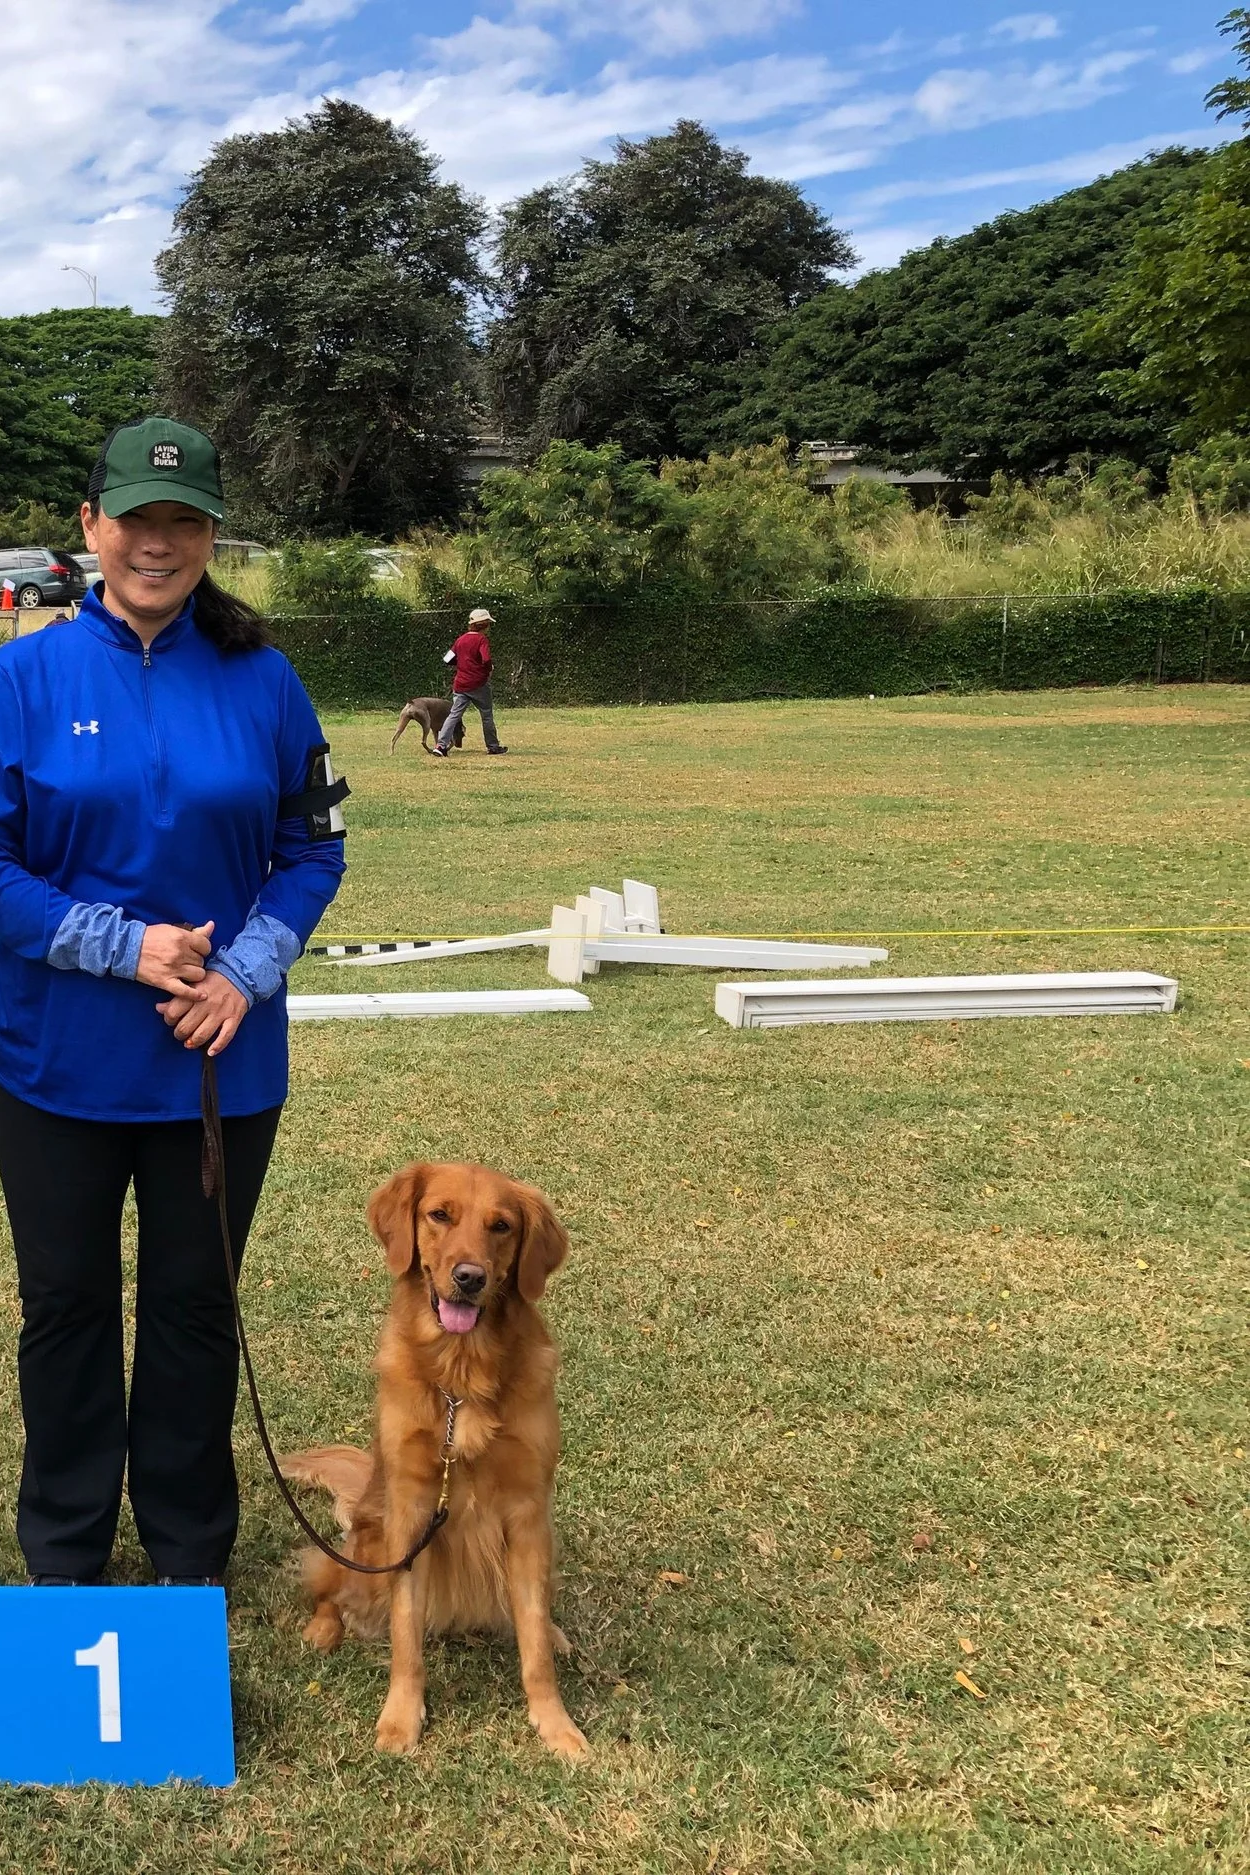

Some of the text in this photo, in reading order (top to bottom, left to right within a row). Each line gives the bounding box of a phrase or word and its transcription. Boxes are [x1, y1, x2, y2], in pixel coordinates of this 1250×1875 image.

[162, 445, 179, 455] VIDA
[153, 456, 179, 467] BUENA
[75, 1631, 122, 1743] 1
